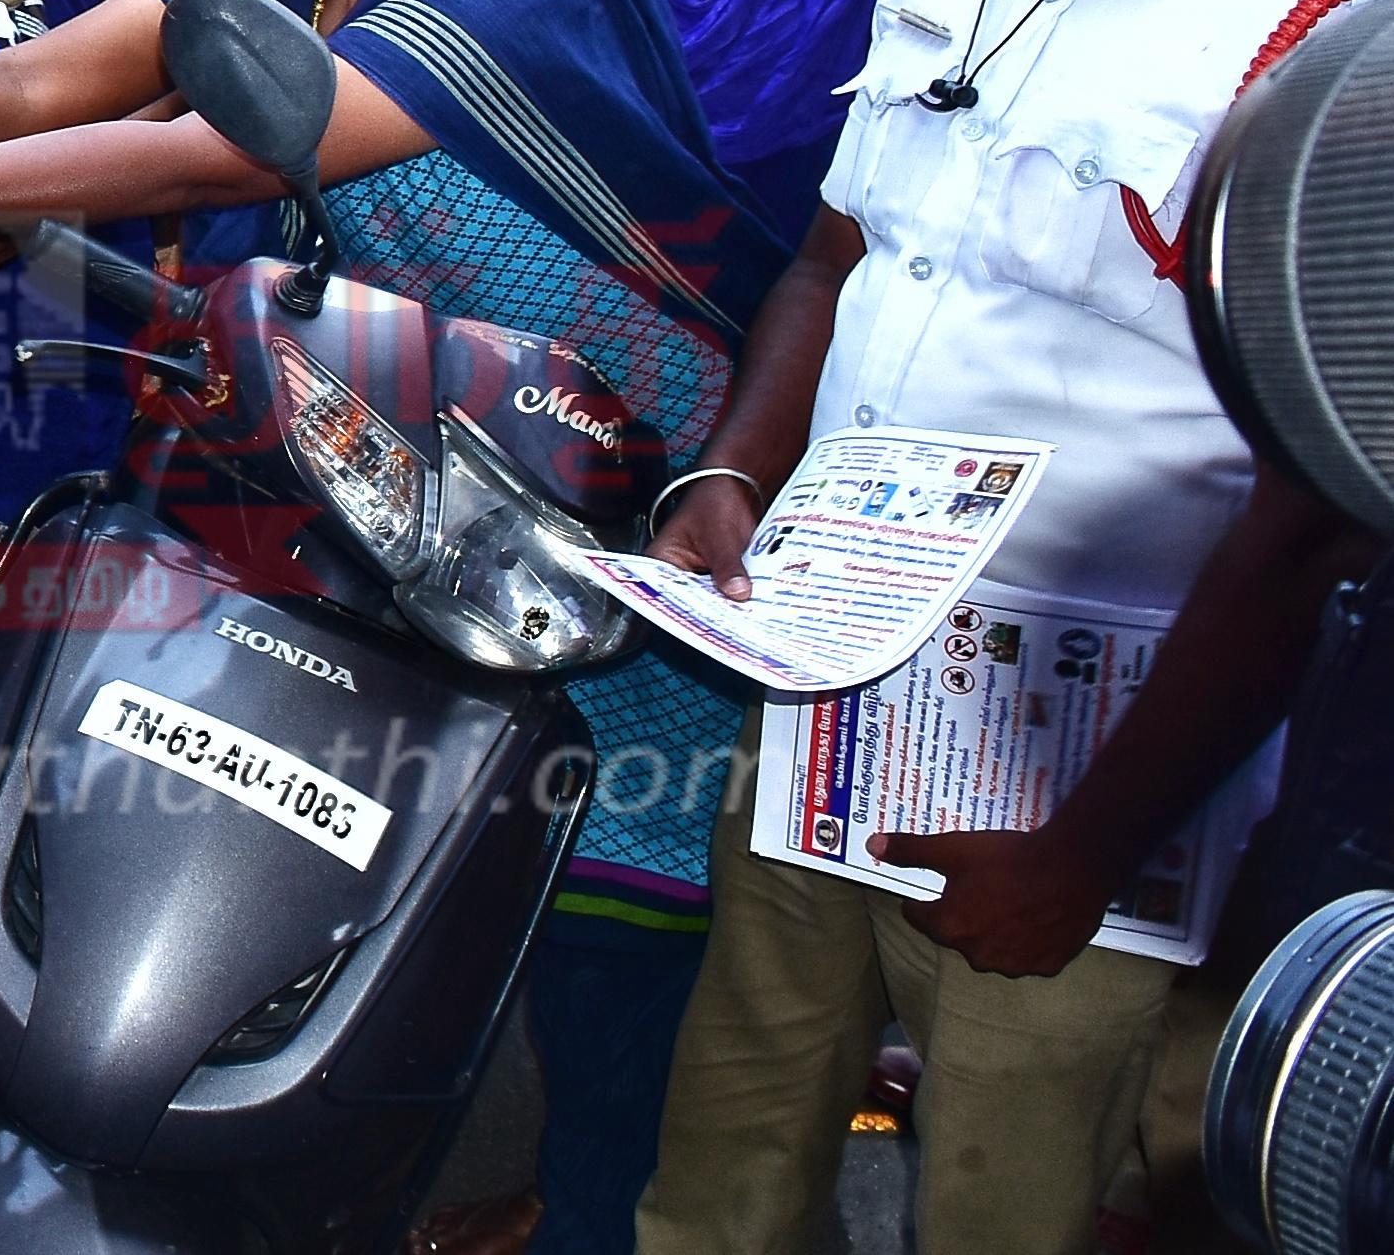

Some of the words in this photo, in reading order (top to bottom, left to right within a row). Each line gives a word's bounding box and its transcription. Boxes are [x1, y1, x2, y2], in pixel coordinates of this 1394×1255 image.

[213, 616, 359, 693] HONDA
[816, 731, 831, 769] மாநகர
[852, 720, 879, 823] போக்குவரத்து
[813, 770, 827, 806] மதுரை
